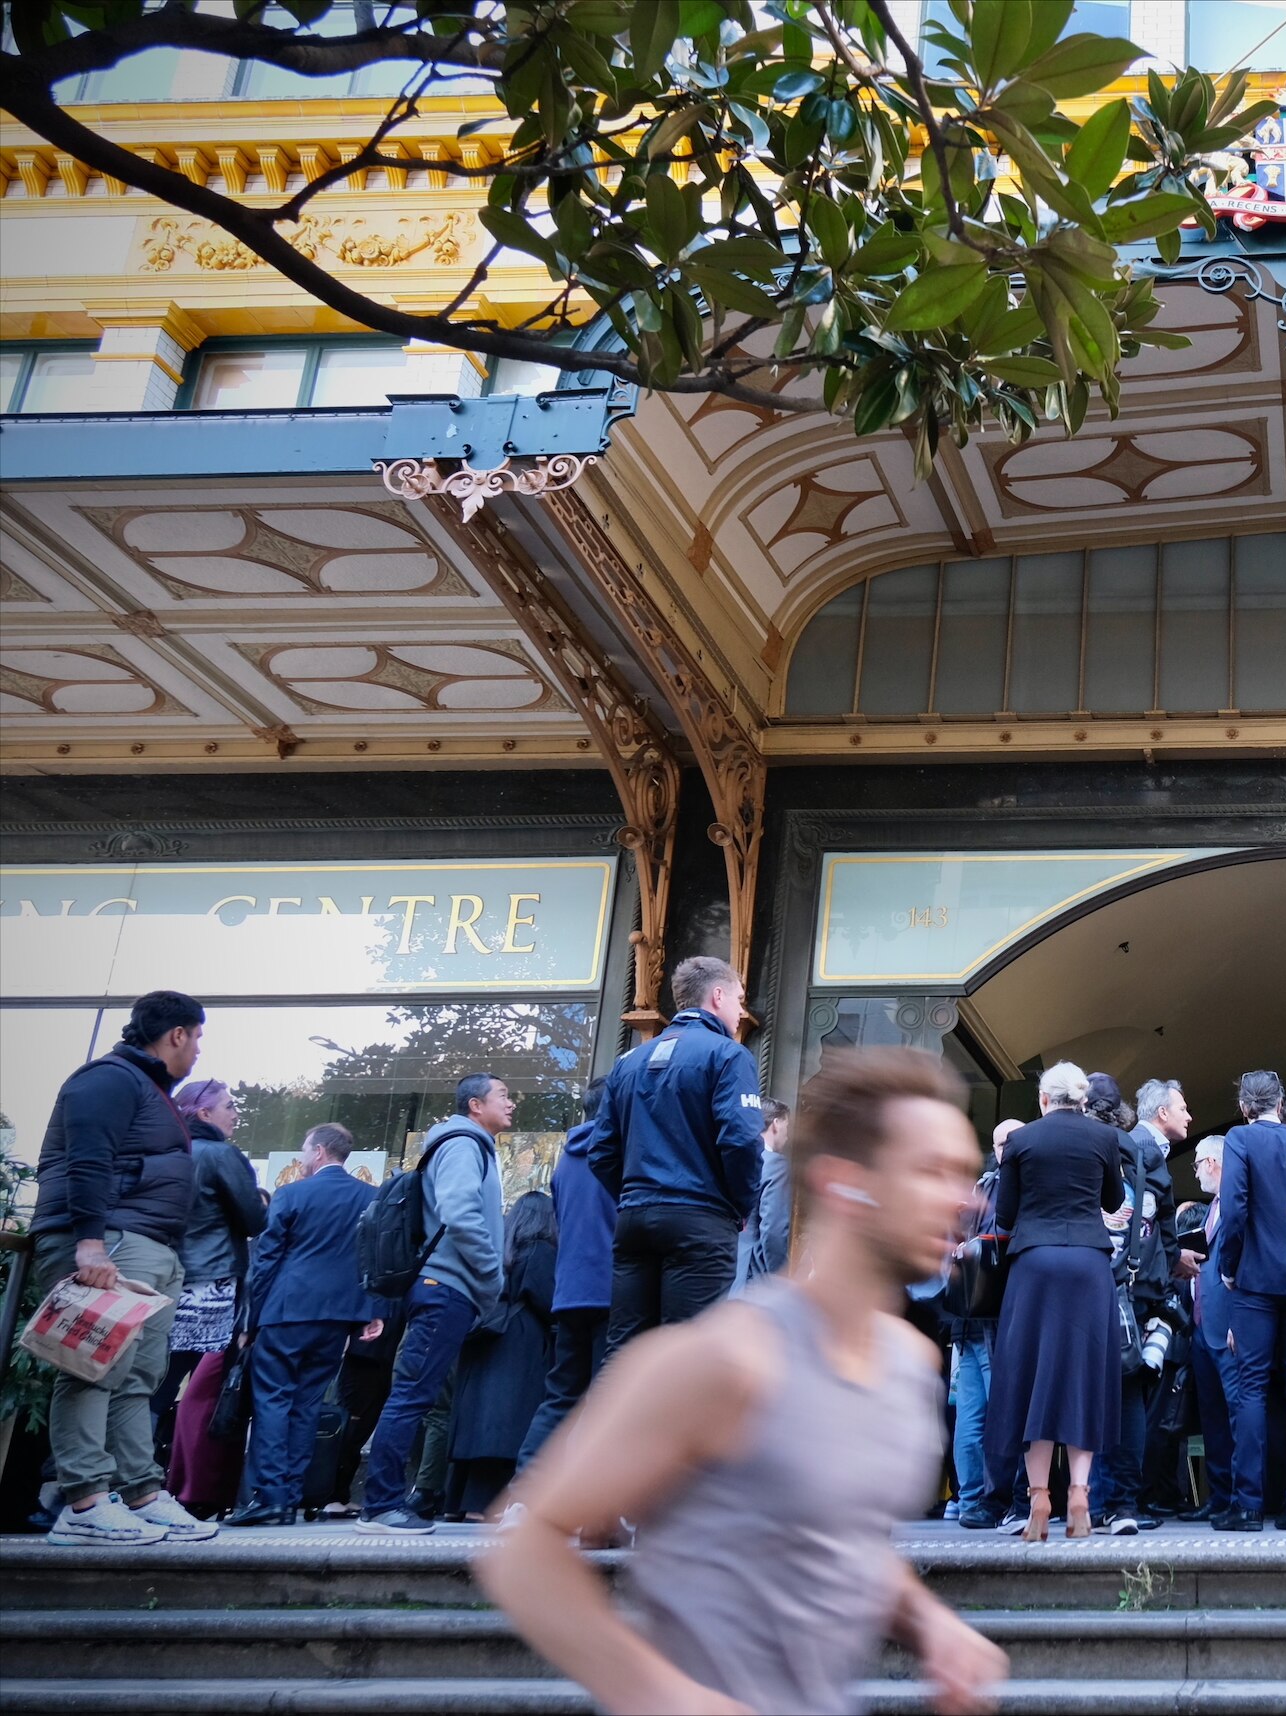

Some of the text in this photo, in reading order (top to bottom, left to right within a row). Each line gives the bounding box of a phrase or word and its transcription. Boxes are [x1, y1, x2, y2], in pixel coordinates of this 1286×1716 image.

[1227, 200, 1277, 213] RECENS
[907, 906, 948, 928] 143
[56, 1318, 83, 1337] Fried
[79, 1329, 111, 1352] Chicken
[72, 1313, 110, 1340] Kentucky
